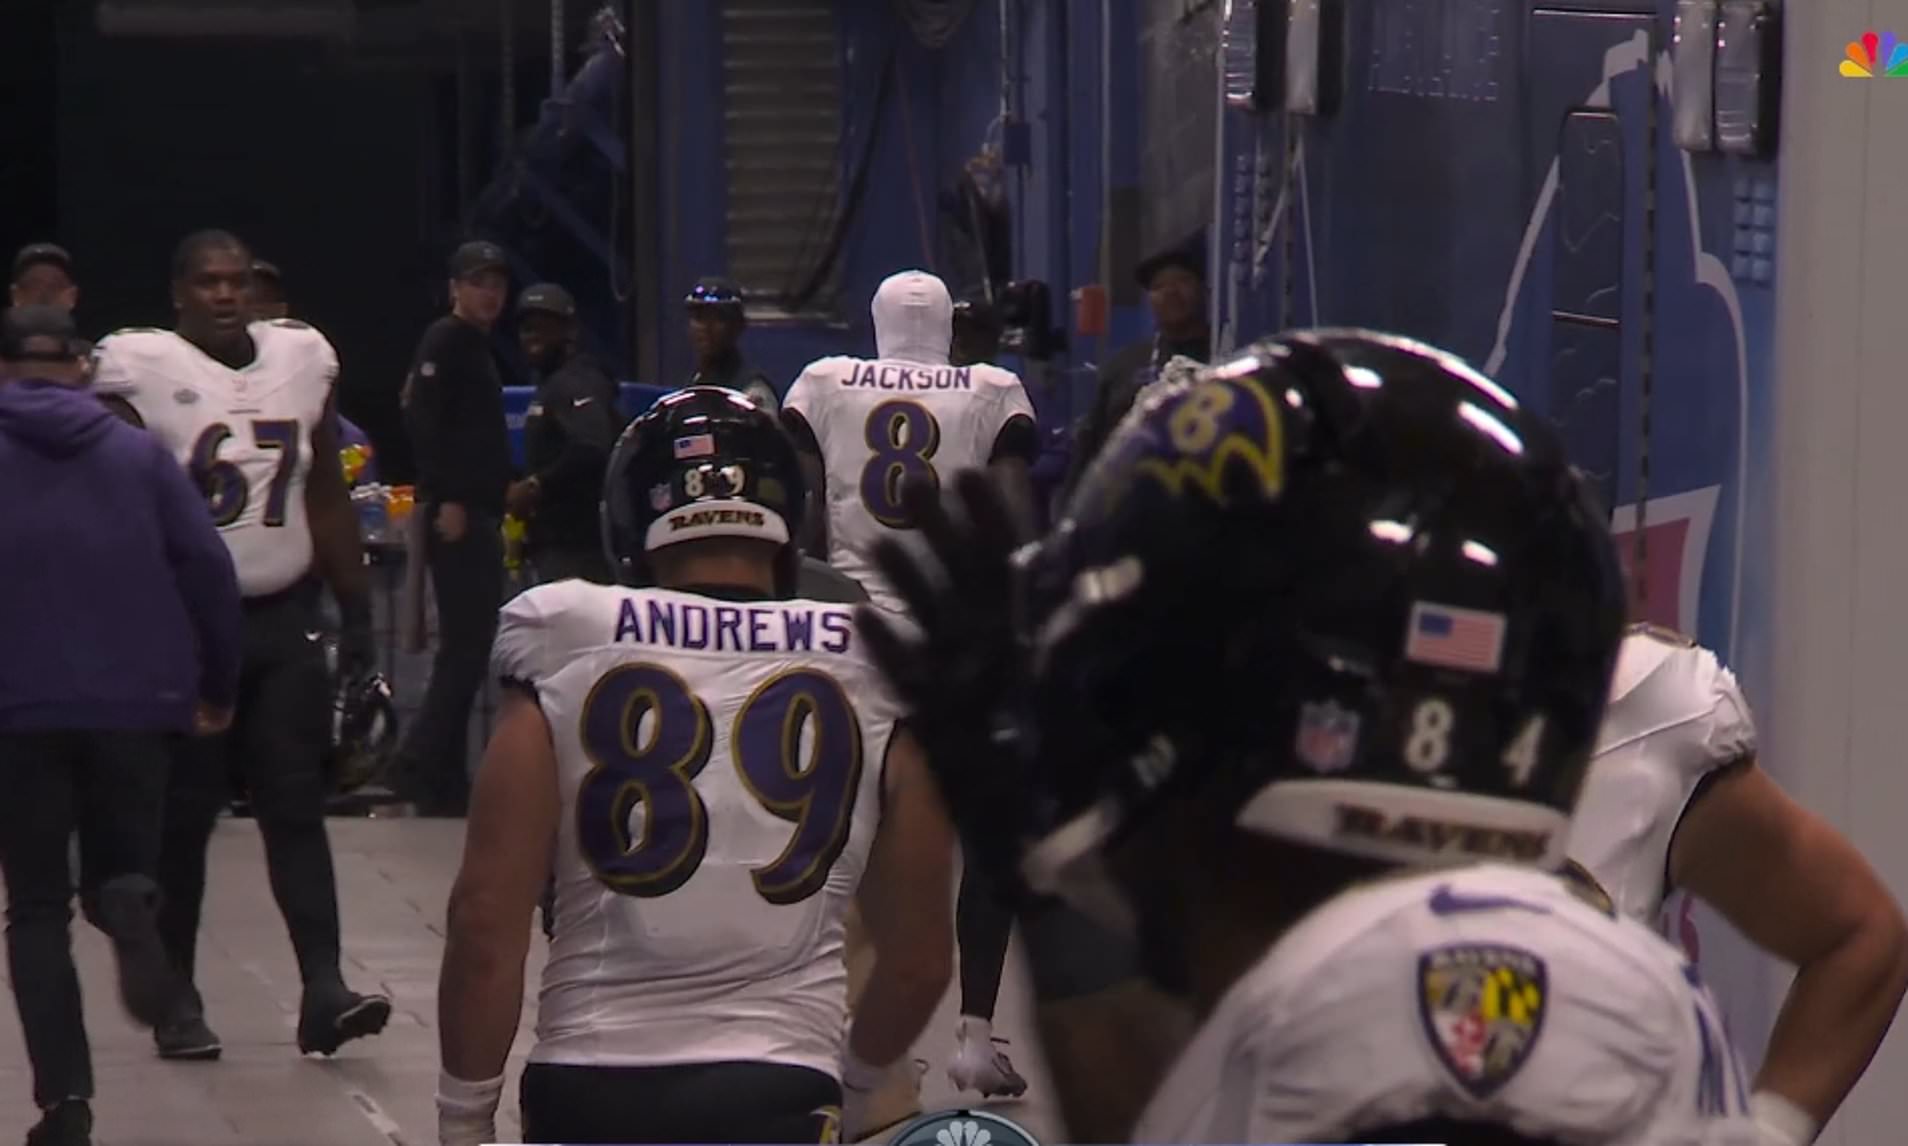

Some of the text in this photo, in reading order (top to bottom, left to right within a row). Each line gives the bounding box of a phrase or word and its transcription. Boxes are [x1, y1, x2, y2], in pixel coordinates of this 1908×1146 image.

[842, 364, 971, 390] JACKSON
[187, 419, 299, 527] 67
[861, 400, 940, 529] 8
[670, 510, 764, 530] RAVENS
[614, 597, 852, 653] ANDREWS
[575, 662, 864, 905] 89
